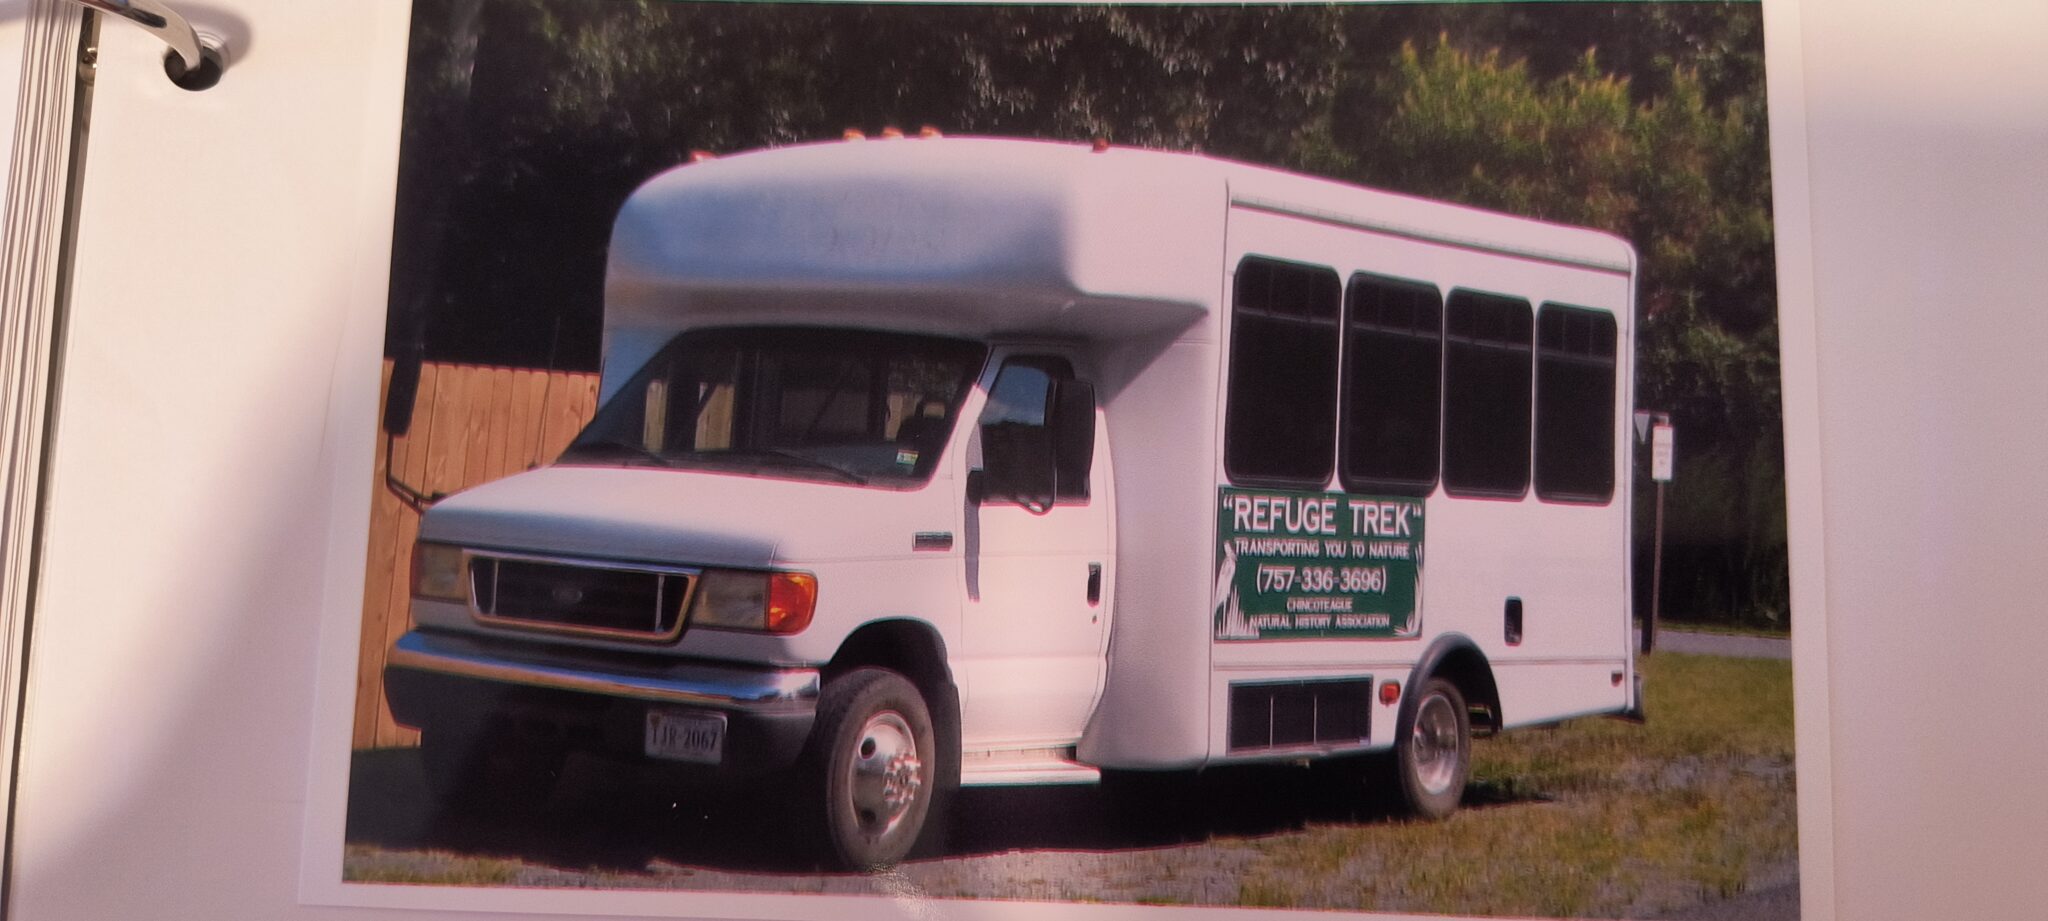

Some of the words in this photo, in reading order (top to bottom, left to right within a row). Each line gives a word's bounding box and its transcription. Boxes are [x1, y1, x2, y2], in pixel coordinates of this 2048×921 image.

[1235, 539, 1319, 557] TRANSPORTING
[1324, 542, 1346, 558] YOU
[1351, 543, 1365, 558] TO
[1369, 544, 1409, 559] NATURE
[1256, 564, 1387, 595] (757-336-3696)
[1286, 598, 1353, 612] CHINCOTEAGUE
[1250, 615, 1291, 629] NATURAL
[1295, 615, 1330, 628] HISTORY
[1335, 615, 1390, 629] ASSOCIATION
